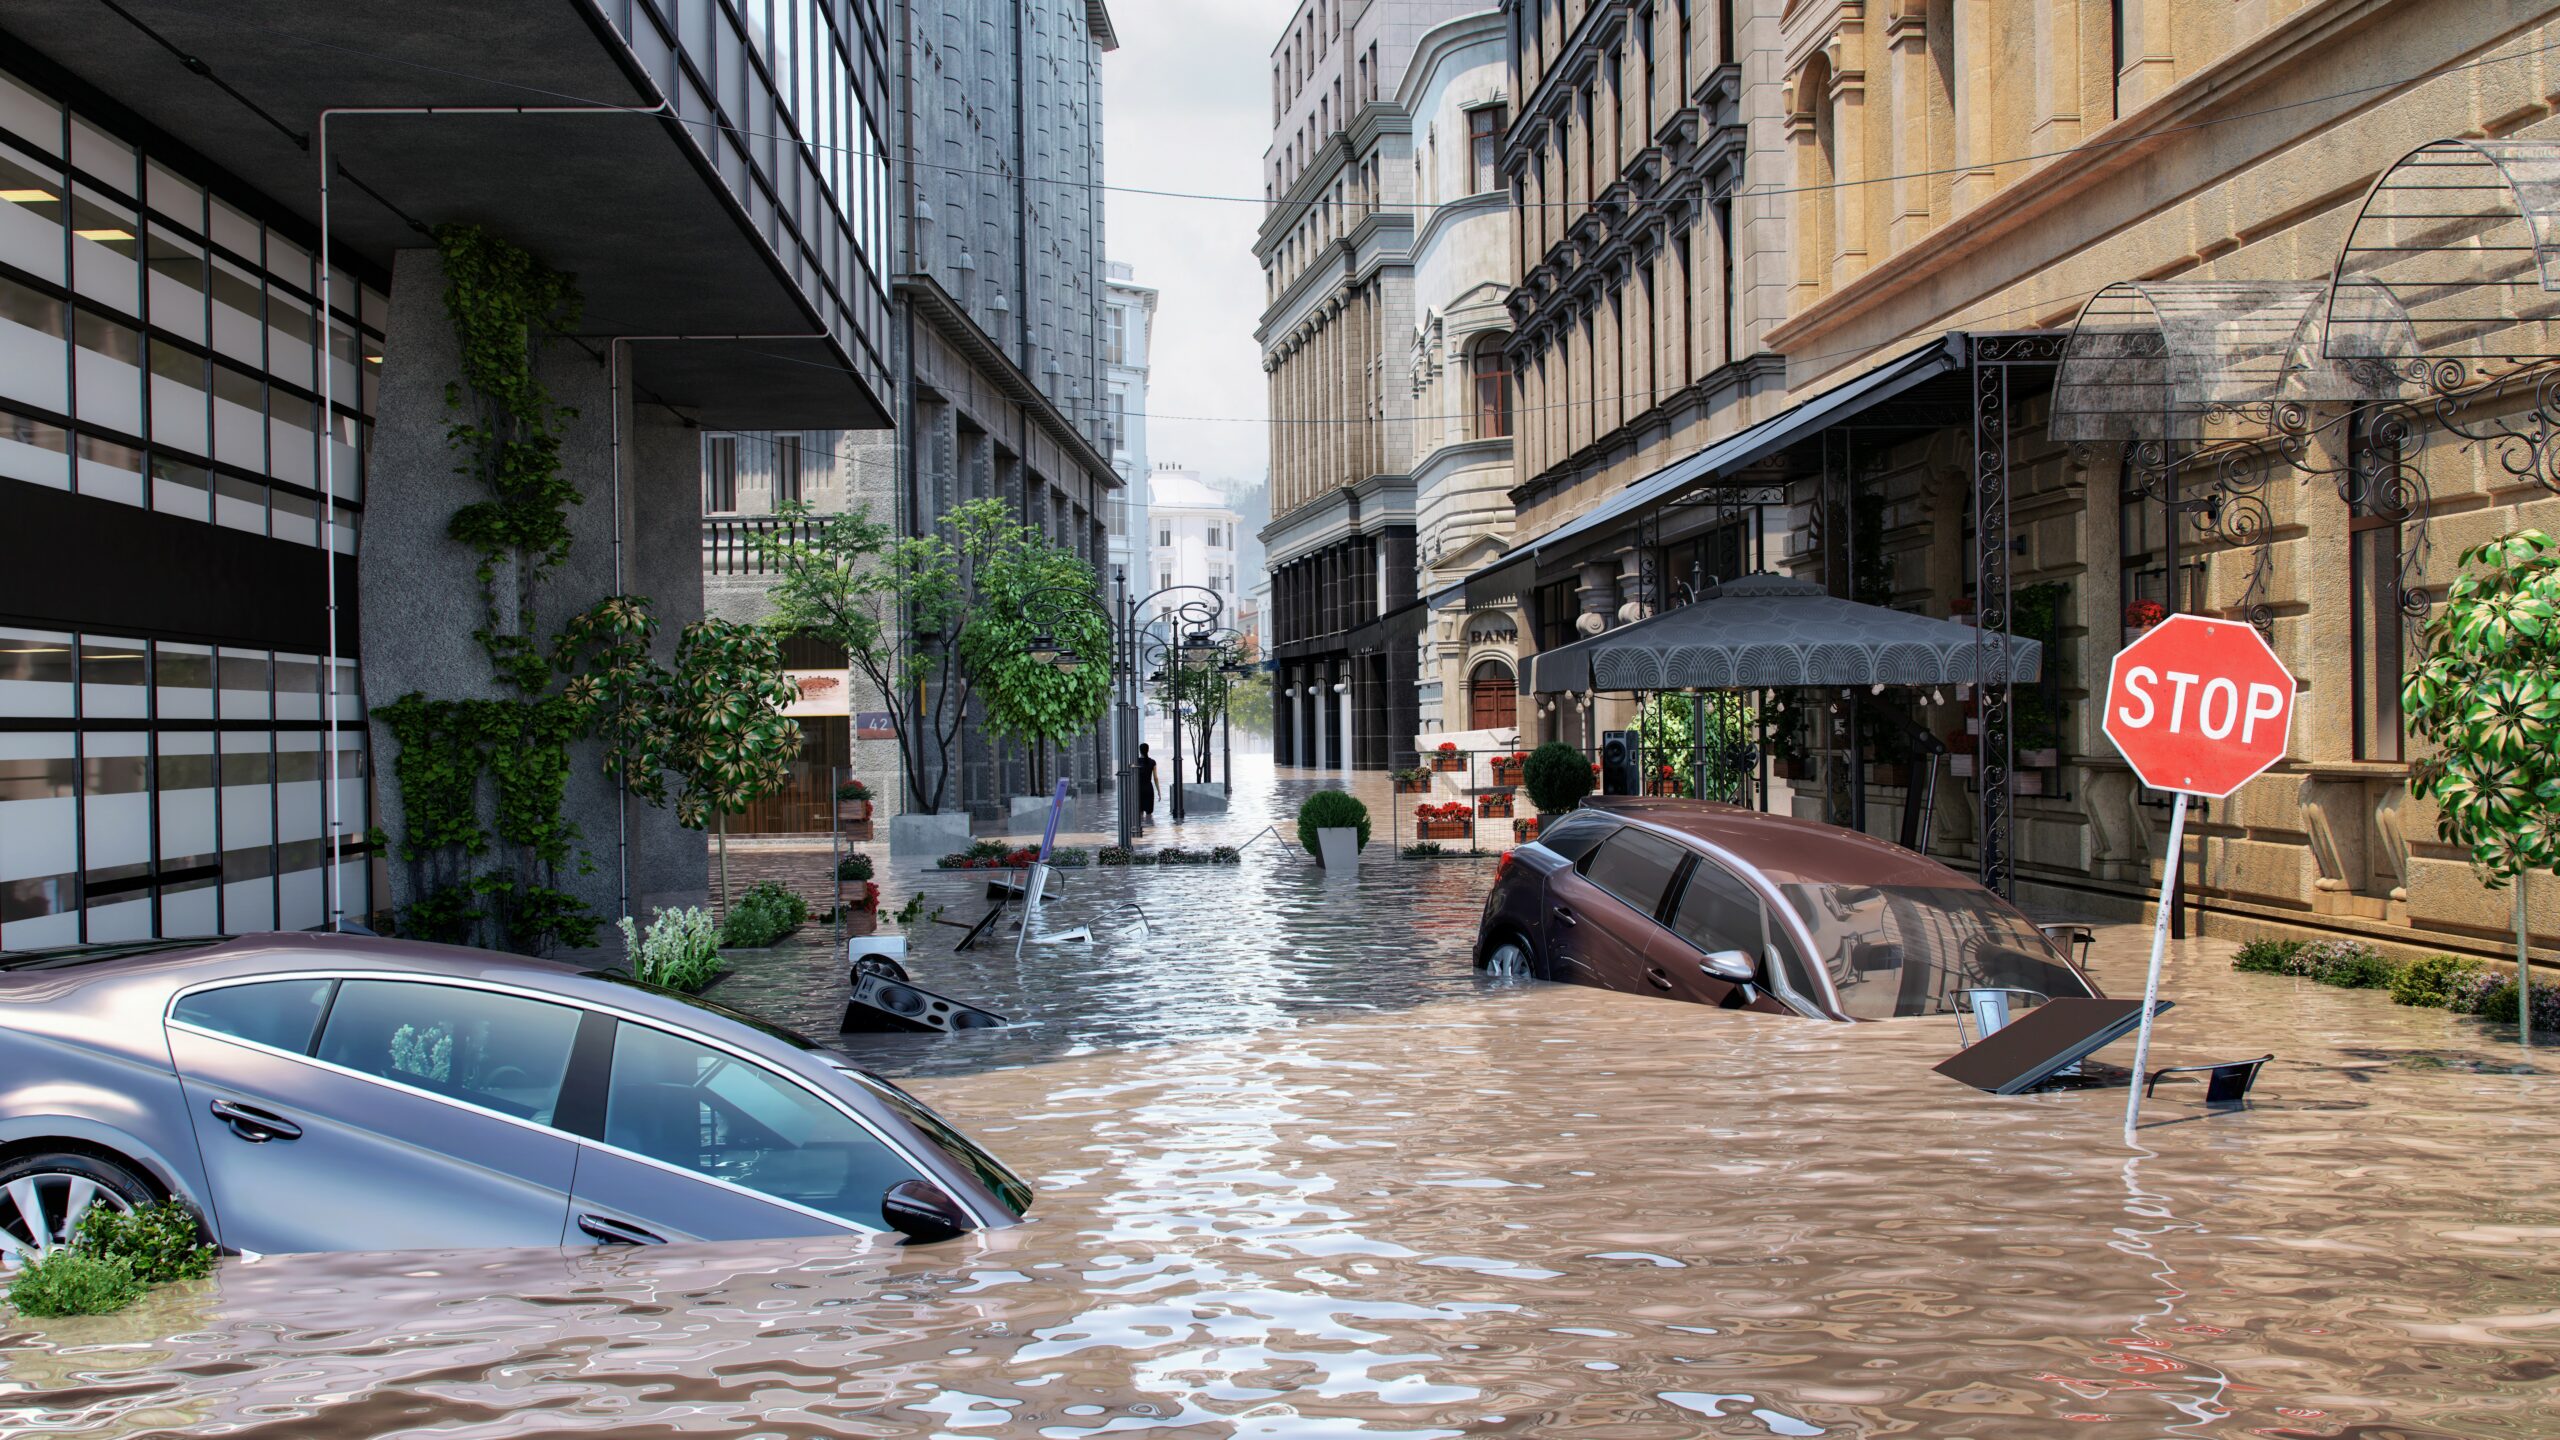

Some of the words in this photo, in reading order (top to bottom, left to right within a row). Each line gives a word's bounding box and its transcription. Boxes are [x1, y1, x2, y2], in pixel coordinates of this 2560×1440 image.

[1470, 629, 1518, 643] BANK
[2118, 665, 2284, 744] STOP
[869, 718, 888, 731] 42
